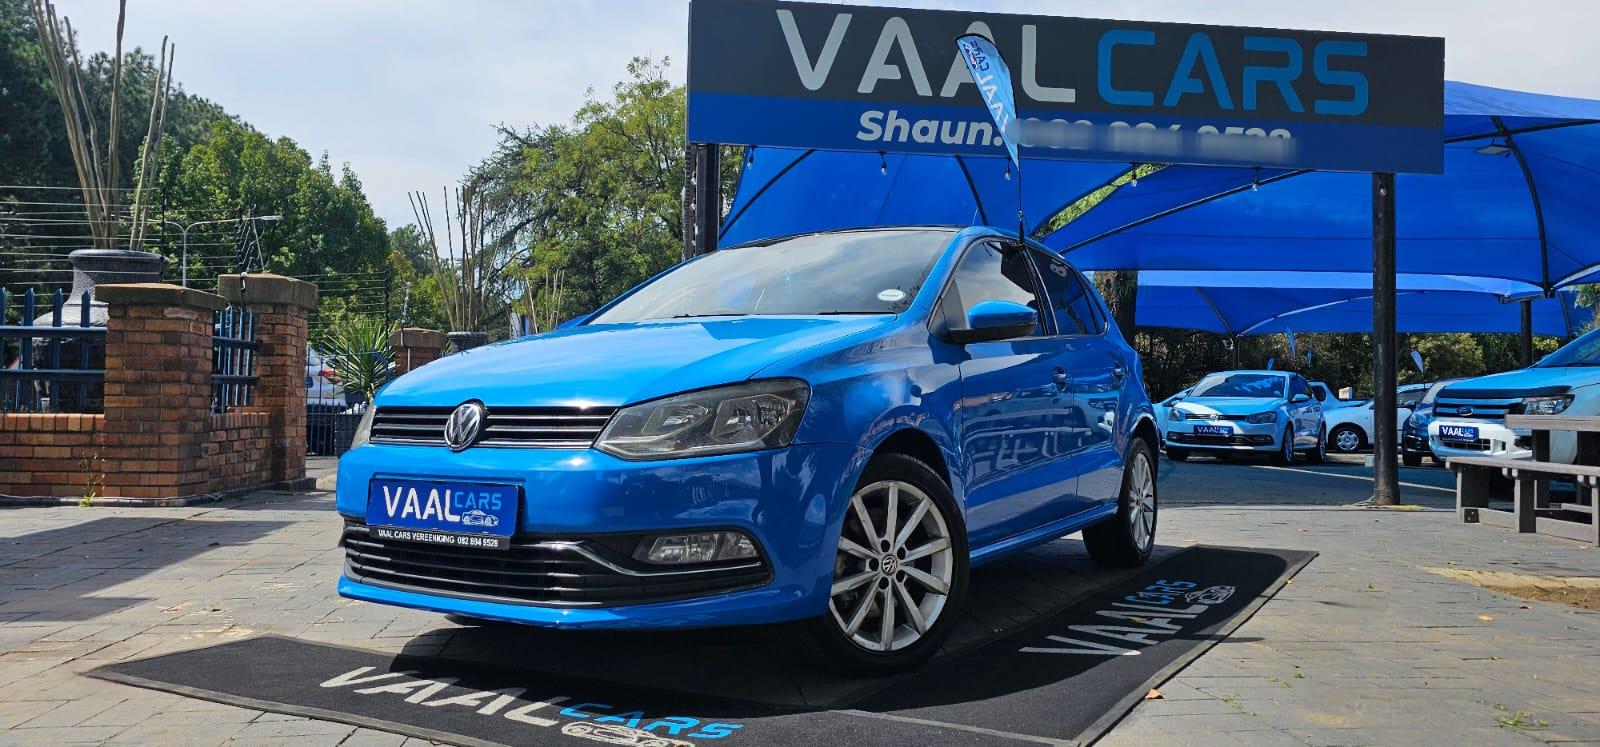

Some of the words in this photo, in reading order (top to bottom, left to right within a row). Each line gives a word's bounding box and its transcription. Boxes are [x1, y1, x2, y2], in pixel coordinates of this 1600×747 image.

[776, 8, 1076, 103] VAAL
[1097, 29, 1369, 115] CARS
[1442, 426, 1463, 436] VAAL
[383, 486, 460, 522] VAAL
[454, 491, 502, 510] CARS
[378, 529, 393, 538] VAAL
[394, 531, 411, 540] CARS
[457, 537, 469, 545] 082
[1019, 602, 1209, 656] VAAL
[1124, 579, 1198, 605] CARS
[319, 666, 572, 726] VAAL
[559, 702, 743, 739] CARS
